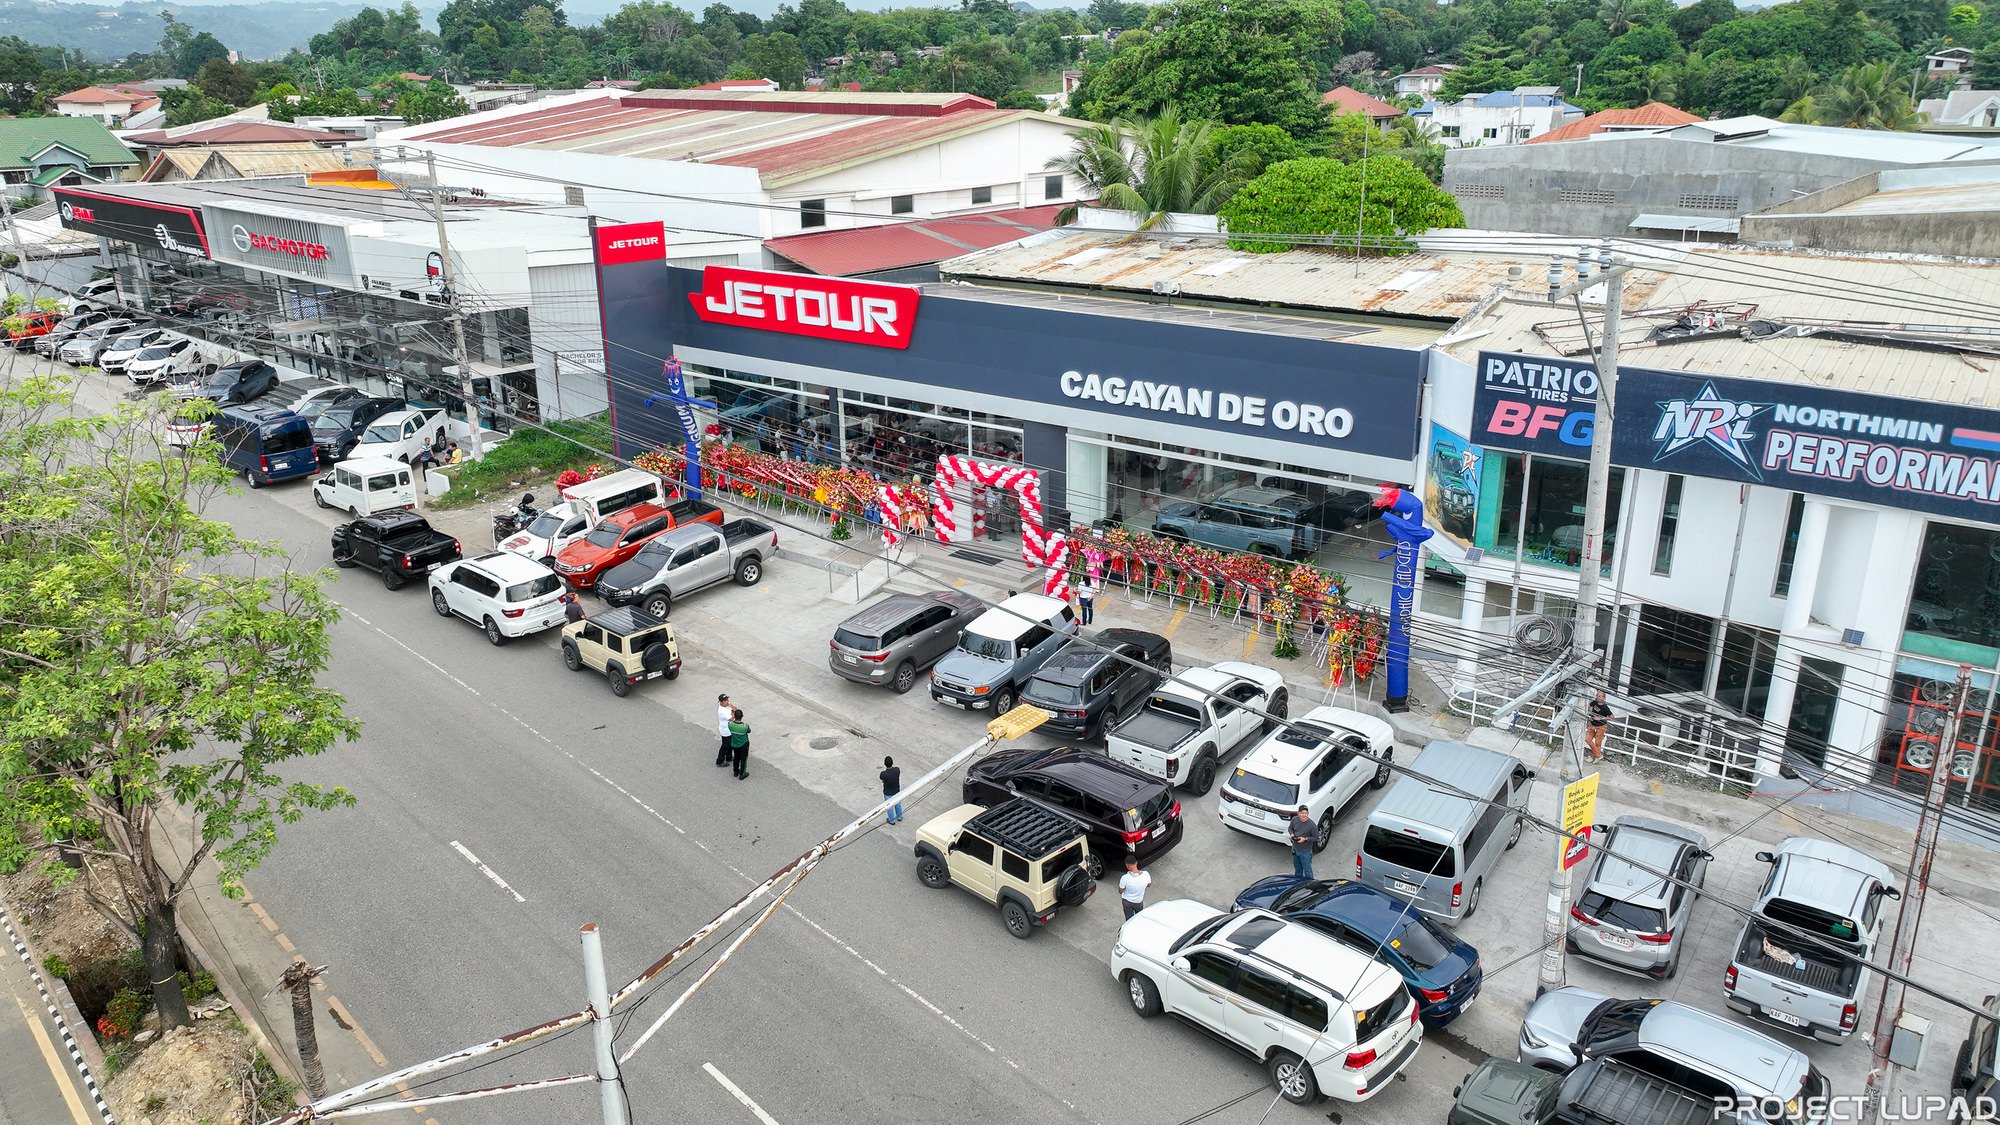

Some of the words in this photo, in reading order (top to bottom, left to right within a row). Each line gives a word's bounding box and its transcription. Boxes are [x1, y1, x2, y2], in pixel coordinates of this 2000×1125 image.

[250, 233, 277, 251] GAC
[277, 238, 328, 260] MOTOR
[608, 236, 659, 250] JETOUR
[706, 280, 899, 337] JETOUR
[1485, 358, 1619, 395] PATRIO
[1060, 370, 1213, 419] CAGAYAN
[1218, 392, 1267, 427] DE
[1272, 400, 1354, 439] ORO
[1530, 387, 1569, 404] TIRES
[1774, 403, 1944, 444] NORTHMIN
